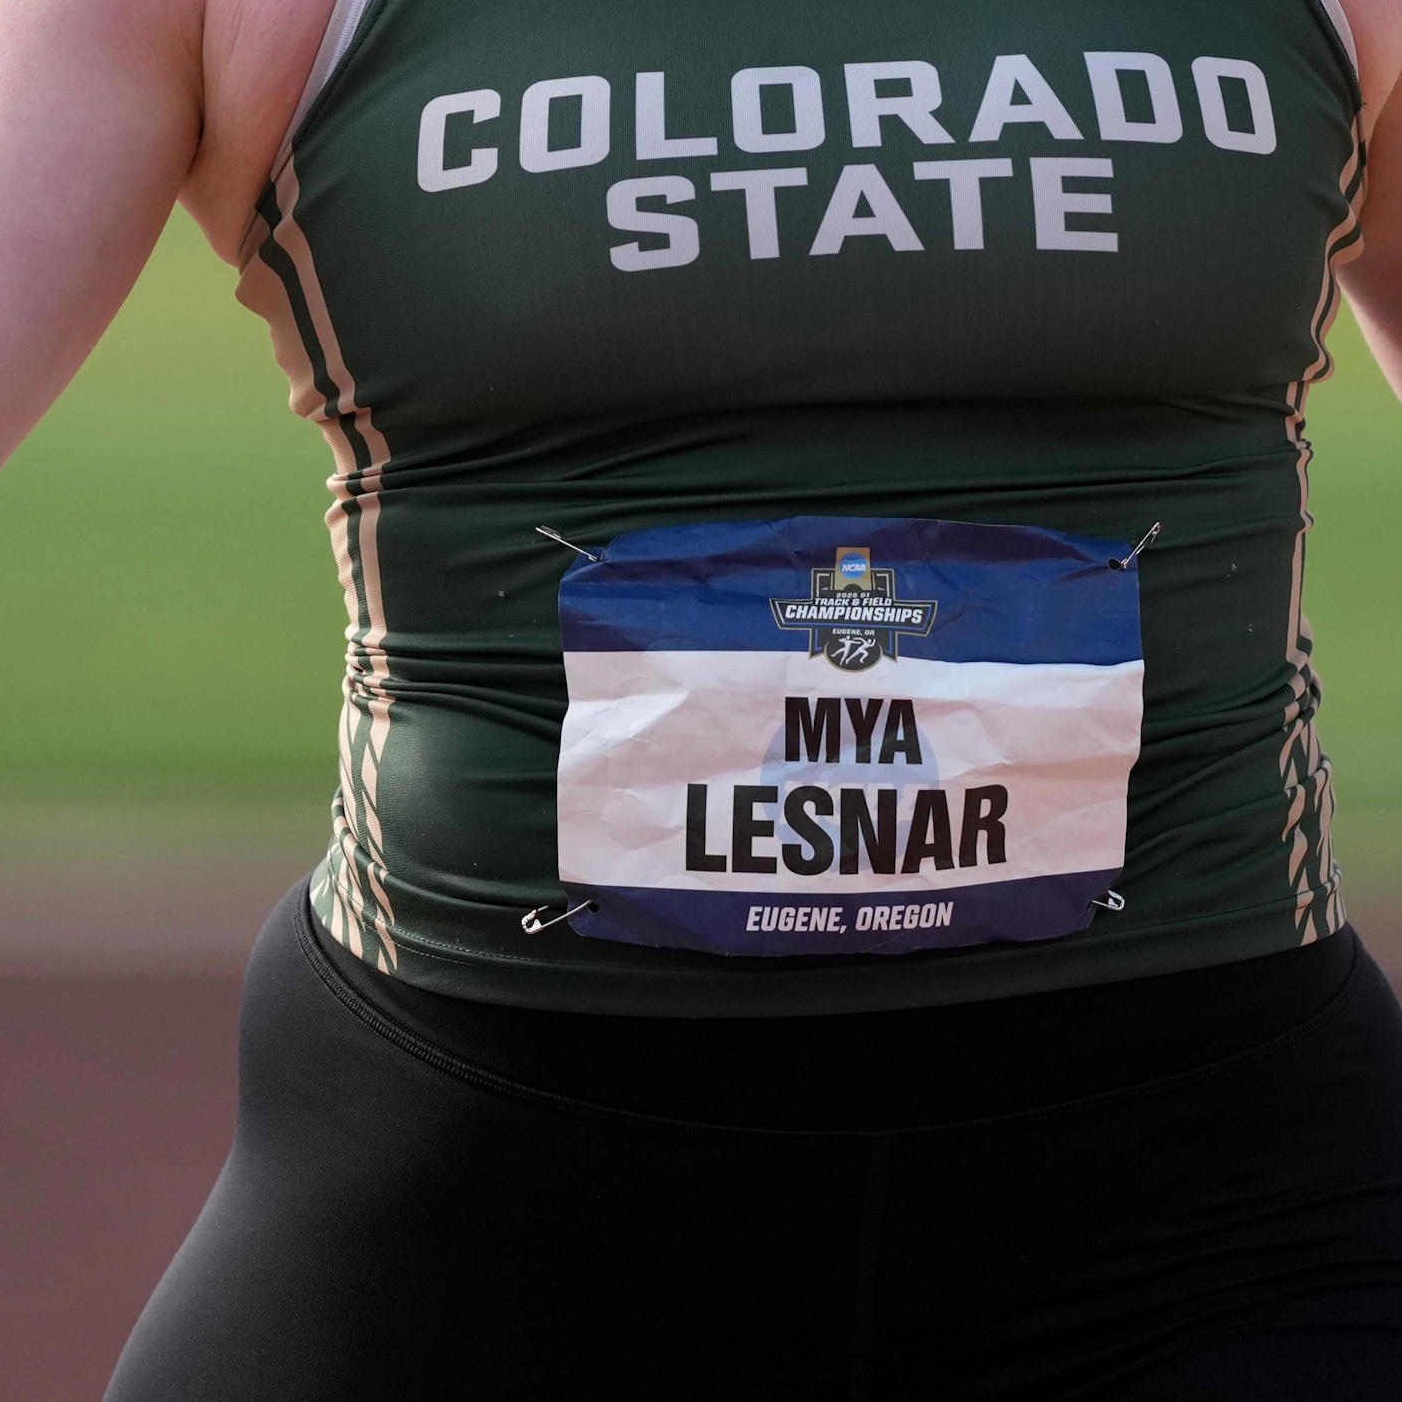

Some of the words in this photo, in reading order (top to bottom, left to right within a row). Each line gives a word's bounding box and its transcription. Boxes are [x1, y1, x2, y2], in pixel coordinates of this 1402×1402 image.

[417, 51, 1277, 193] COLORADO
[606, 157, 1119, 273] STATE
[841, 563, 867, 572] NCAA
[785, 604, 924, 624] CHAMPIONSHIPS
[814, 597, 849, 605] TRACK
[851, 597, 861, 606] &
[862, 597, 892, 606] FIELD
[832, 628, 863, 636] EUGENE,
[784, 696, 922, 765] MYA
[685, 783, 1009, 875] LESNAR
[745, 905, 848, 934] EUGENE,
[854, 901, 954, 931] OREGON
